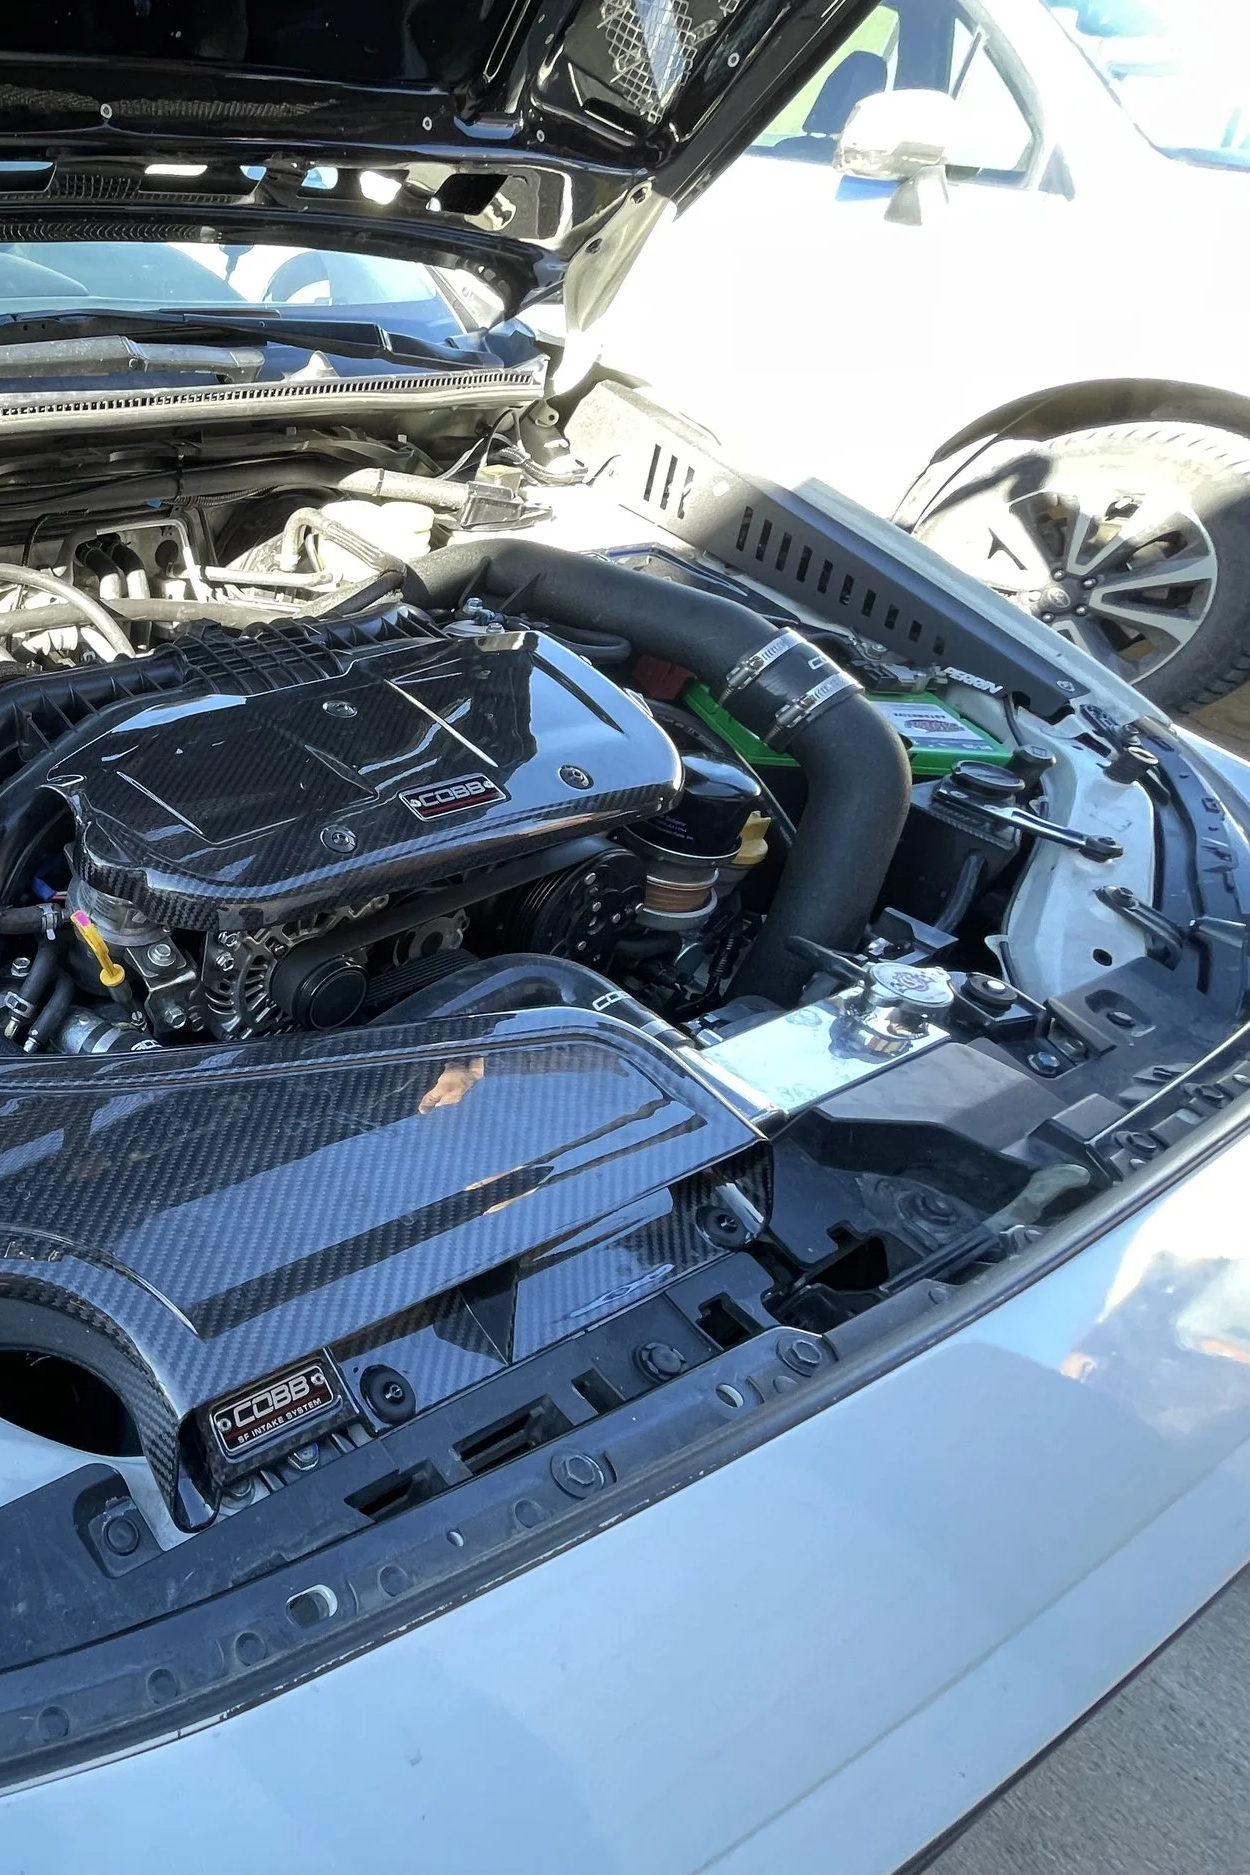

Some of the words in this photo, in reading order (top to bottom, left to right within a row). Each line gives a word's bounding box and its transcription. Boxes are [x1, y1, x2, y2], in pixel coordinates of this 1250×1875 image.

[943, 666, 1004, 694] PERRIN
[418, 781, 486, 807] COBB
[592, 990, 633, 1011] CO
[233, 1375, 310, 1428] COBB
[237, 1433, 250, 1444] SF
[252, 1416, 285, 1437] INTAKE
[286, 1397, 322, 1420] SYSTEM
